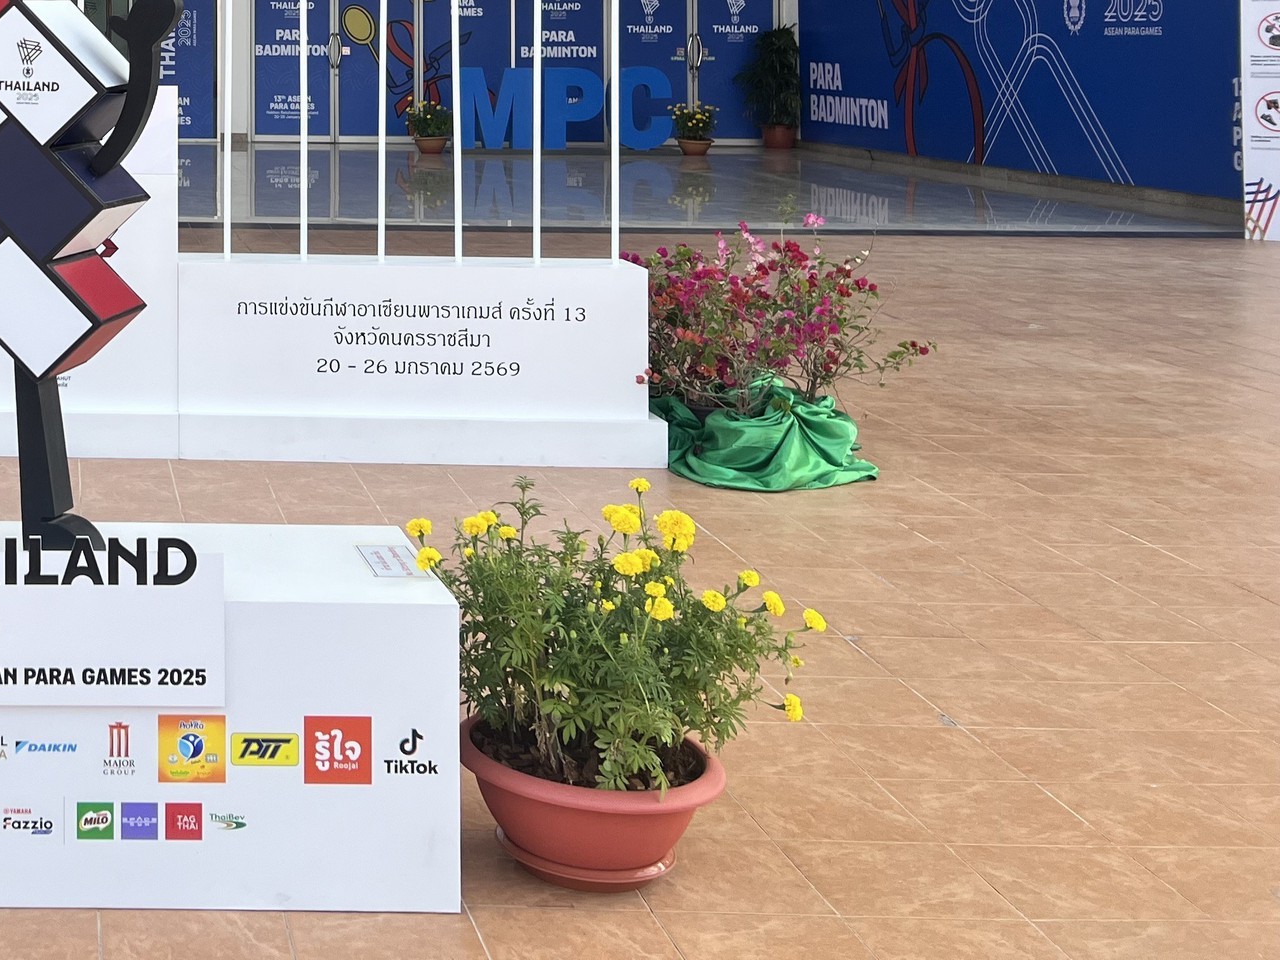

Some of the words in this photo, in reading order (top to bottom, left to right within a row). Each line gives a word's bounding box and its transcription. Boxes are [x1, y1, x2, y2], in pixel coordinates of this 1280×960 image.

[452, 7, 483, 16] AMES
[276, 29, 309, 40] PAR
[627, 25, 673, 33] THAILAND
[712, 25, 759, 33] THAILAND
[1104, 27, 1123, 36] ASEAN
[1124, 27, 1140, 35] PARA
[1140, 26, 1163, 35] GAMES
[542, 30, 575, 42] PARA
[809, 61, 842, 91] PARA
[459, 66, 673, 151] MPC
[810, 93, 889, 130] BADMINTON
[236, 296, 503, 321] การแข่งขันกีฬาอาเซียนพาราเกมส์
[509, 298, 556, 322] ครั้งที่
[563, 307, 586, 322] 13
[333, 325, 492, 348] จังหวัดนครราชสีมา
[316, 358, 341, 374] 20
[363, 359, 388, 375] 26
[394, 360, 465, 376] มกราคม
[470, 361, 521, 377] 2569
[24, 668, 77, 686] PARA
[81, 668, 152, 686] GAMES
[157, 668, 207, 686] 2025
[27, 743, 78, 753] DAIKIN
[238, 737, 294, 760] PTT
[103, 759, 135, 769] MAJOR
[383, 759, 439, 775] TikTok
[83, 816, 109, 826] MILO
[177, 815, 196, 823] TAG
[209, 813, 246, 821] ThaiBev
[3, 817, 53, 830] Fazzio
[177, 822, 199, 830] THAI
